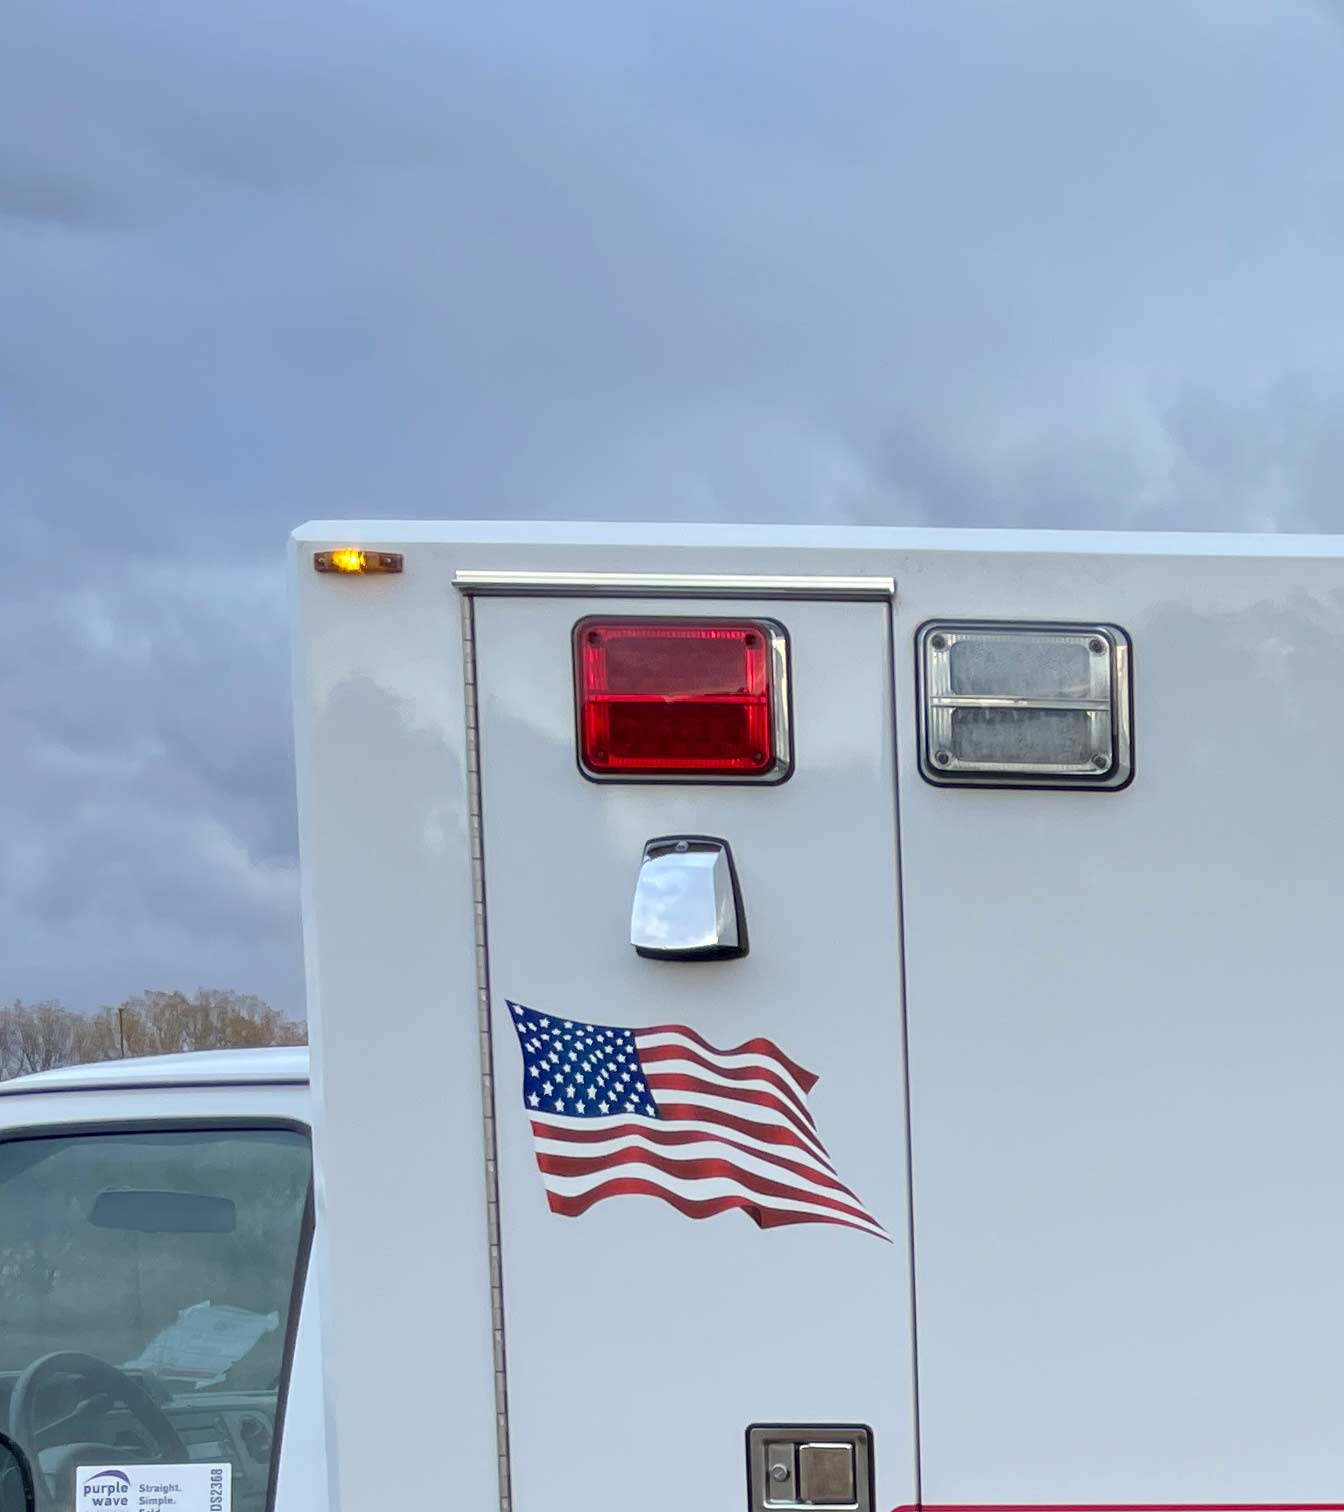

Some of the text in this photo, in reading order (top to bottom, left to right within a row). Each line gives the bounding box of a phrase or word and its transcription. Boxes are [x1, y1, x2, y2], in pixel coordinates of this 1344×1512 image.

[83, 1481, 129, 1496] purple
[139, 1484, 182, 1494] Straight.
[210, 1469, 223, 1511] DS2368
[92, 1497, 129, 1506] wave
[139, 1496, 176, 1506] Simple.
